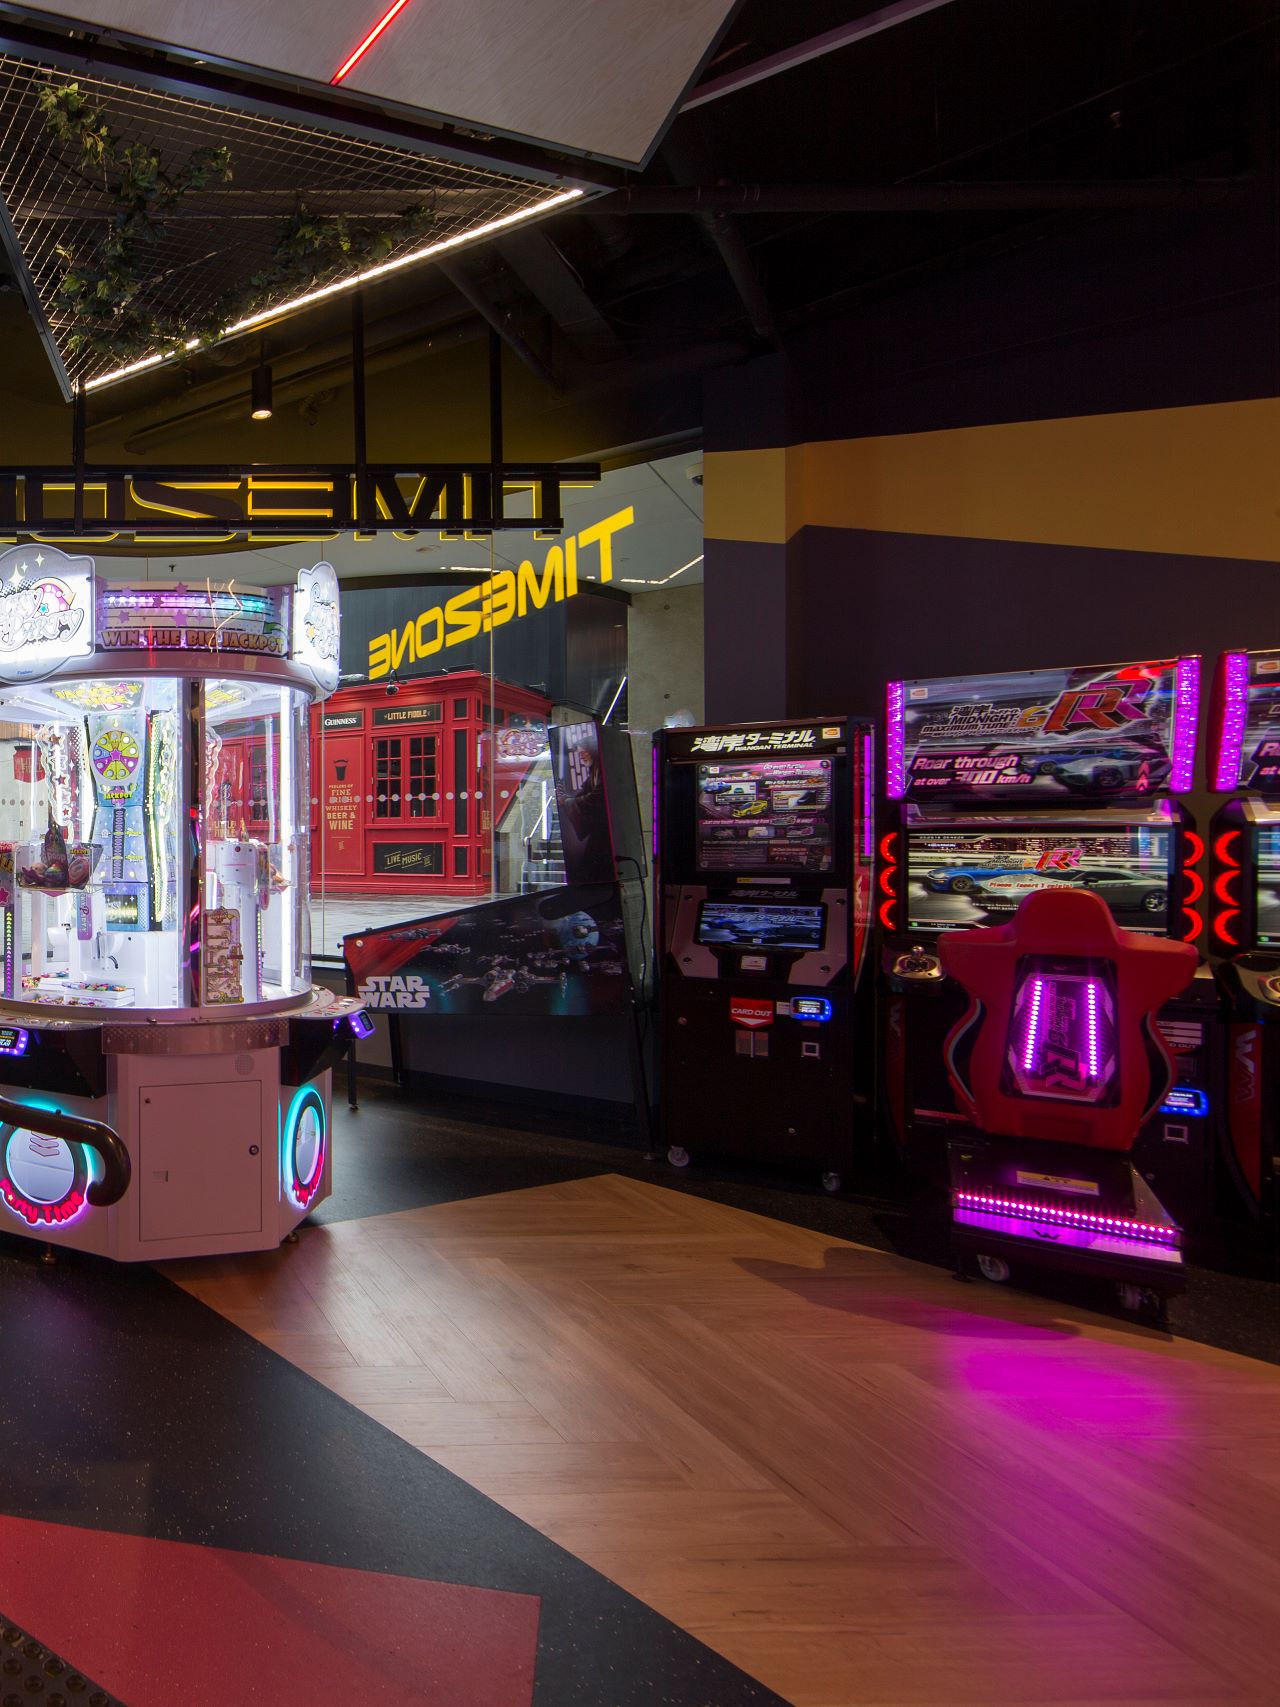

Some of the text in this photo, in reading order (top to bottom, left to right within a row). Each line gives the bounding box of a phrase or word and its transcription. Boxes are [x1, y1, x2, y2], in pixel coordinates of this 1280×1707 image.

[101, 630, 285, 654] WIN THE BIG JACKPOT
[387, 709, 427, 720] LITTLE FIDDLE
[951, 713, 1017, 725] MIDNIGHT
[324, 717, 357, 726] GUINNESS
[734, 742, 815, 752] WANGAN TERMINAL
[1259, 742, 1280, 757] R
[913, 754, 1019, 770] Roar through
[913, 770, 1032, 786] at over 300 km/h
[331, 788, 351, 796] FINE
[329, 796, 353, 804] RIH
[350, 811, 356, 819] &
[329, 819, 353, 831] WINE
[387, 853, 401, 865] LIVE
[401, 852, 422, 865] MUSIC
[358, 975, 430, 992] STAR
[359, 991, 431, 1008] WARS
[731, 1008, 773, 1017] CARD OUT
